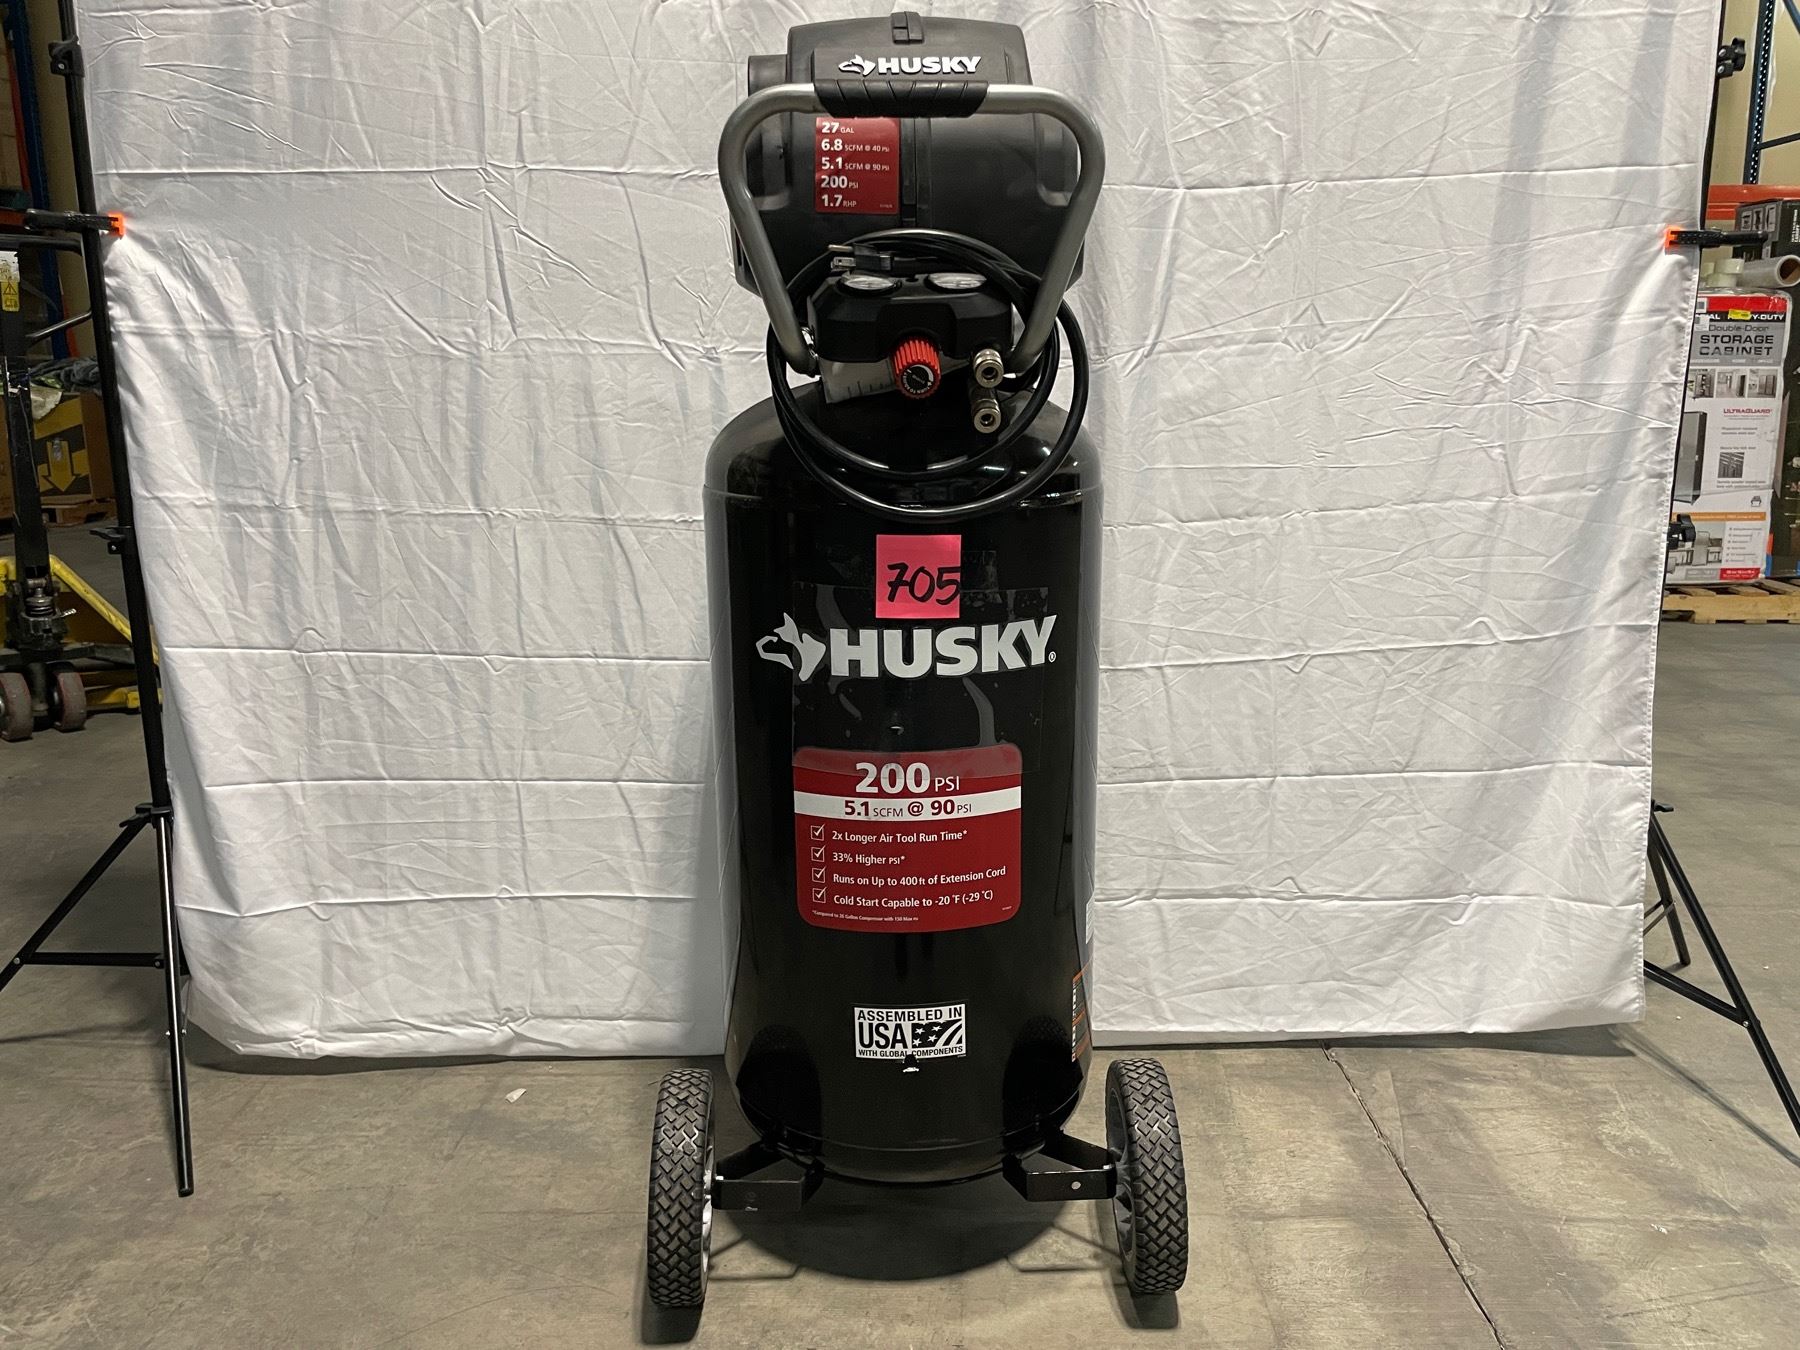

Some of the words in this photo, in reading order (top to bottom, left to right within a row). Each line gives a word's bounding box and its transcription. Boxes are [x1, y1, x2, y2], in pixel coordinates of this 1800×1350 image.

[877, 56, 982, 74] HUSKY
[822, 121, 839, 133] 27
[821, 138, 843, 151] 6.8
[844, 144, 863, 152] SCFM
[821, 157, 843, 170] 5.1
[872, 163, 881, 171] 90
[821, 175, 848, 188] 200
[848, 181, 859, 189] PSI
[821, 194, 843, 207] 1.7
[1708, 324, 1769, 332] Double-Door
[1700, 335, 1774, 344] STORAGE
[1699, 346, 1773, 356] CABINET
[886, 561, 961, 606] 705
[830, 615, 1057, 678] HUSKY
[855, 762, 930, 794] 200
[934, 776, 960, 793] PSI
[844, 801, 870, 817] 5.1
[873, 807, 904, 817] SCFM
[907, 801, 924, 817] @
[930, 799, 955, 816] 90
[956, 804, 972, 814] PSI
[832, 830, 843, 840] 2x
[845, 832, 877, 845] Longer
[879, 833, 894, 843] Air
[896, 833, 917, 843] Tool
[919, 833, 938, 842] Run
[832, 852, 853, 863] 33%
[855, 854, 886, 866] Higher
[833, 873, 855, 884] Runs
[857, 877, 869, 885] on
[871, 876, 885, 887] Up
[887, 878, 897, 886] to
[927, 874, 938, 885] of
[940, 871, 984, 884] Extension
[985, 865, 1006, 878] Cord
[833, 894, 854, 905] Cold
[856, 896, 879, 907] Start
[881, 897, 920, 909] Capable
[922, 898, 933, 907] to
[857, 1009, 943, 1022] ASSEMBLED
[948, 1006, 963, 1019] IN
[858, 1021, 908, 1050] USA
[858, 1049, 878, 1057] WITH
[879, 1050, 908, 1058] GLOBAL
[911, 1045, 963, 1057] COMPONENTS
